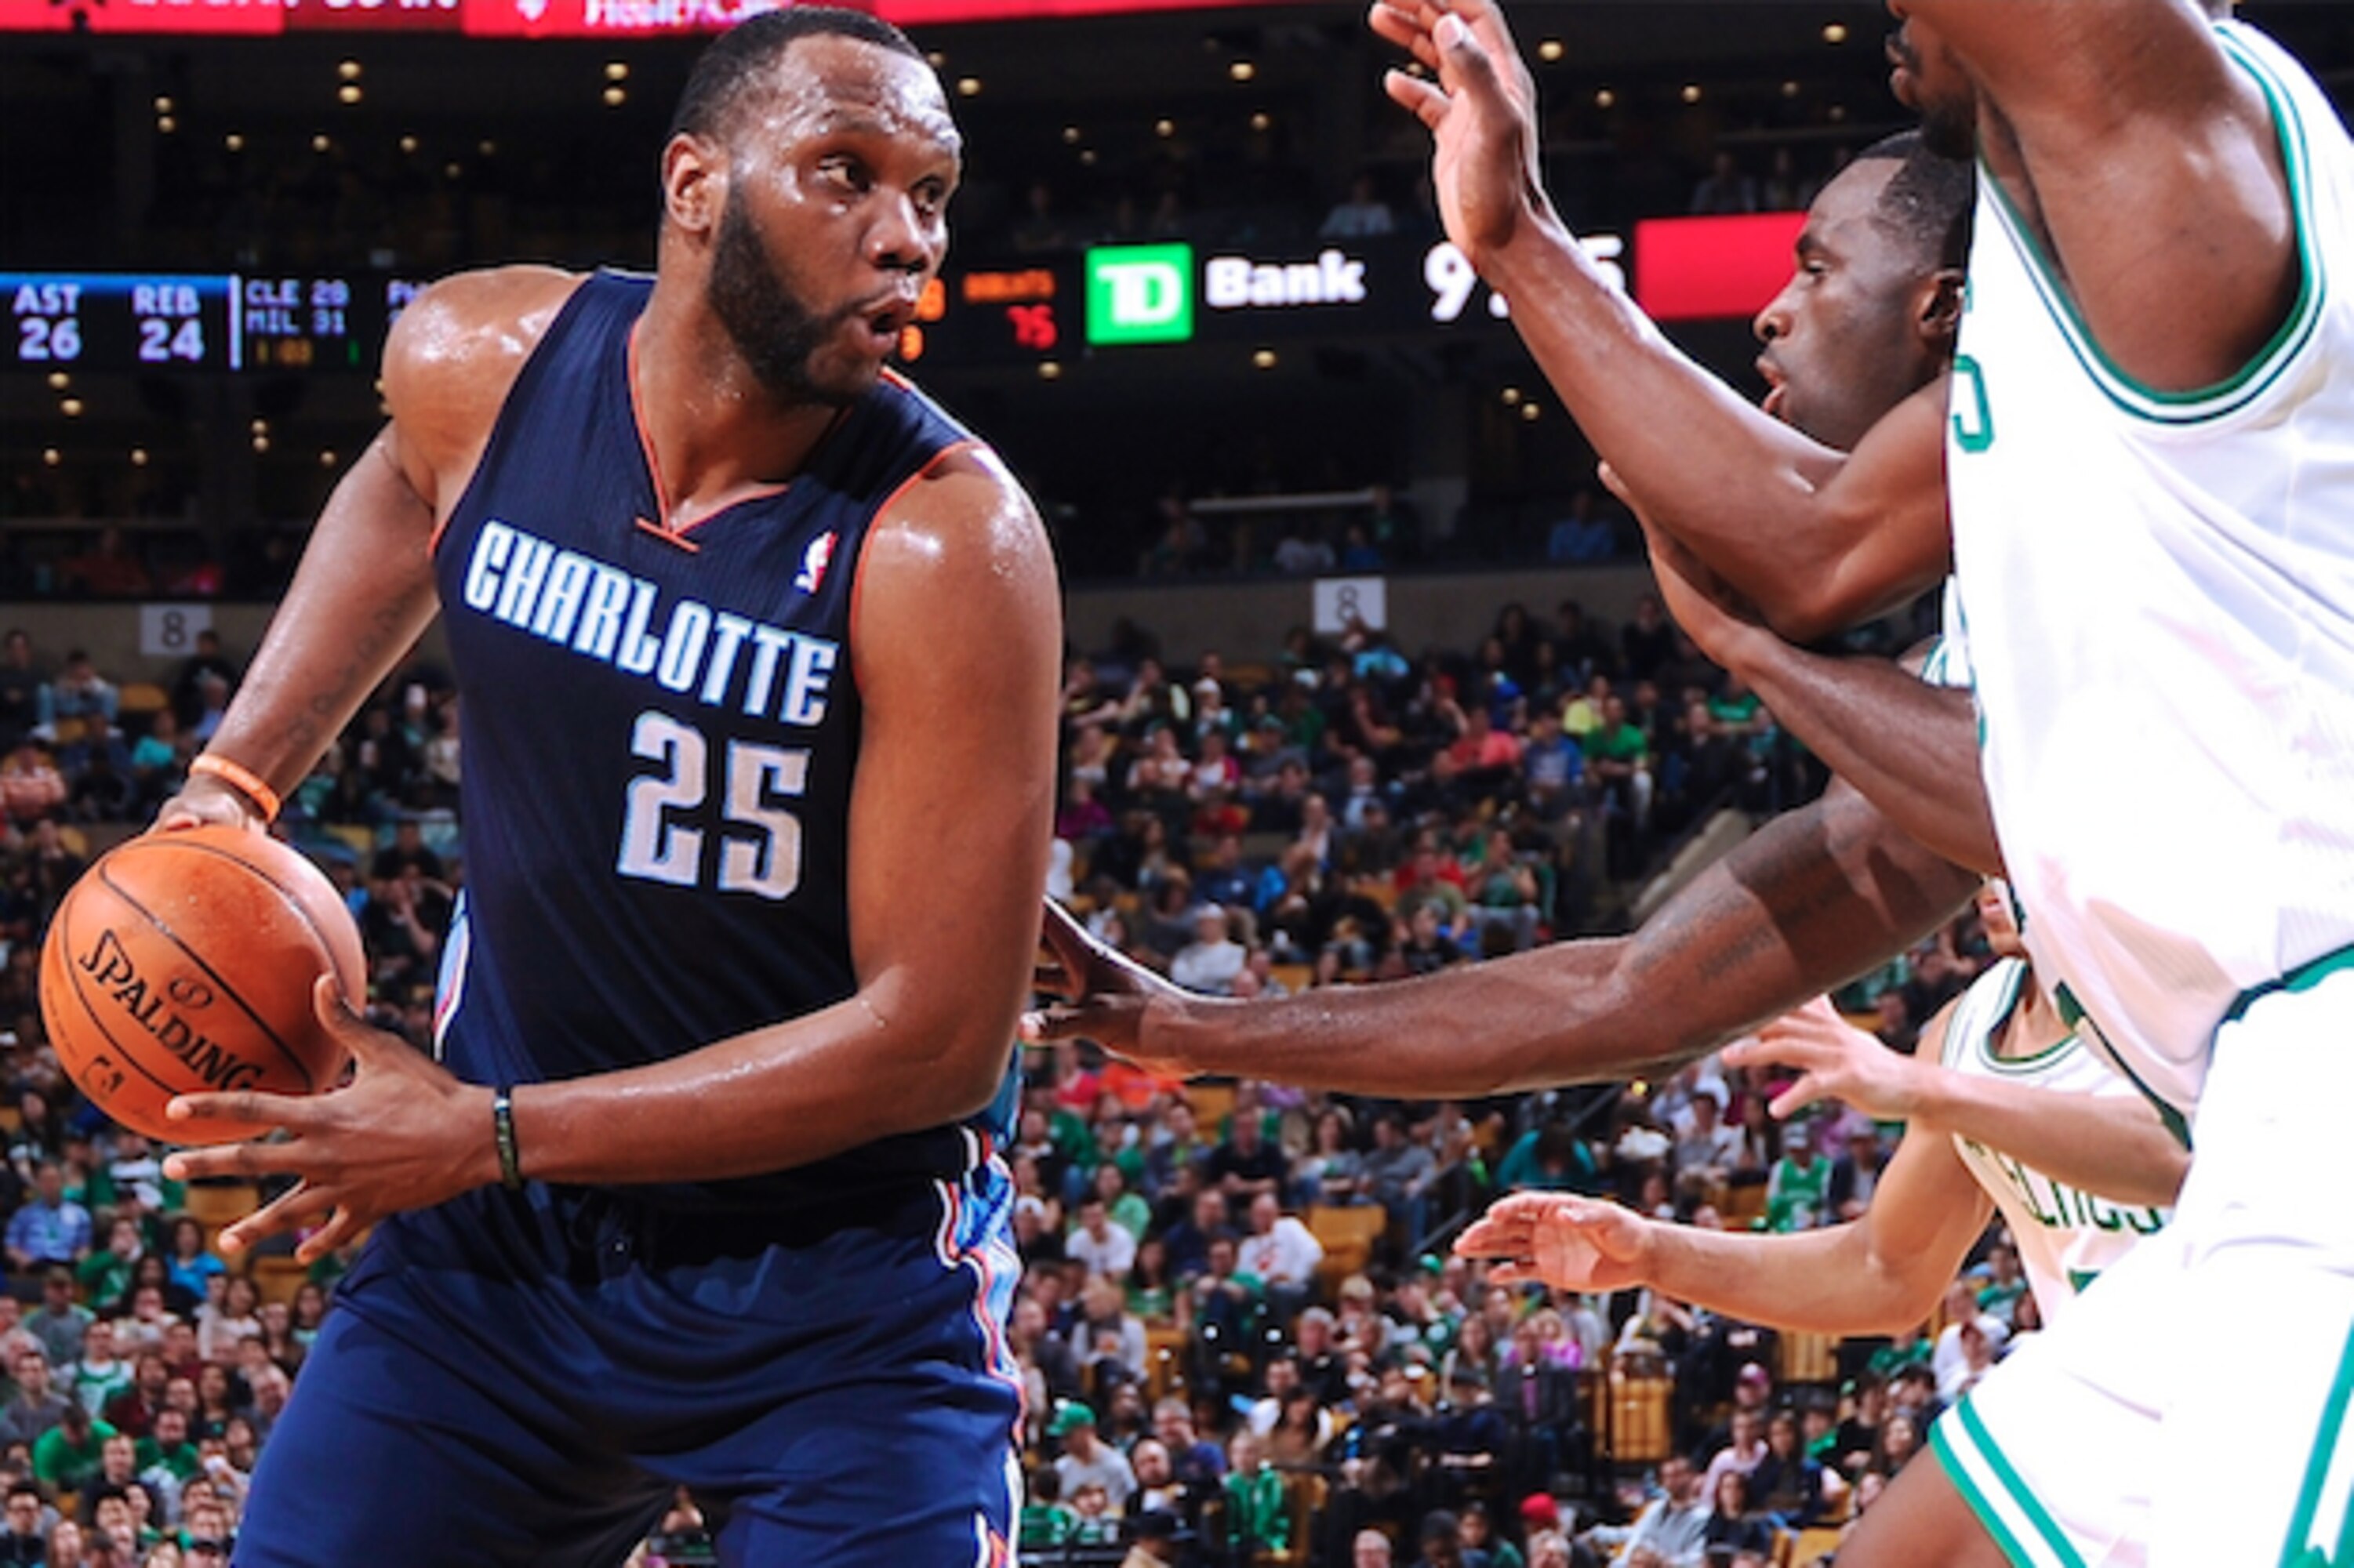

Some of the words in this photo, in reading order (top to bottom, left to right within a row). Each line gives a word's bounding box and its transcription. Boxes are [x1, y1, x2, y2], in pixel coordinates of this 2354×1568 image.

[13, 283, 81, 314] AST
[132, 285, 201, 315] REB
[245, 279, 300, 306] CLE
[1095, 262, 1183, 326] TD
[1205, 249, 1367, 307] Bank
[19, 317, 82, 361] 26
[139, 317, 205, 361] 24
[245, 308, 300, 335] MIL
[464, 519, 840, 727] CHARLOTTE
[1336, 583, 1360, 626] 8
[162, 608, 187, 649] 8
[617, 710, 812, 900] 25
[78, 928, 265, 1092] SPALDING
